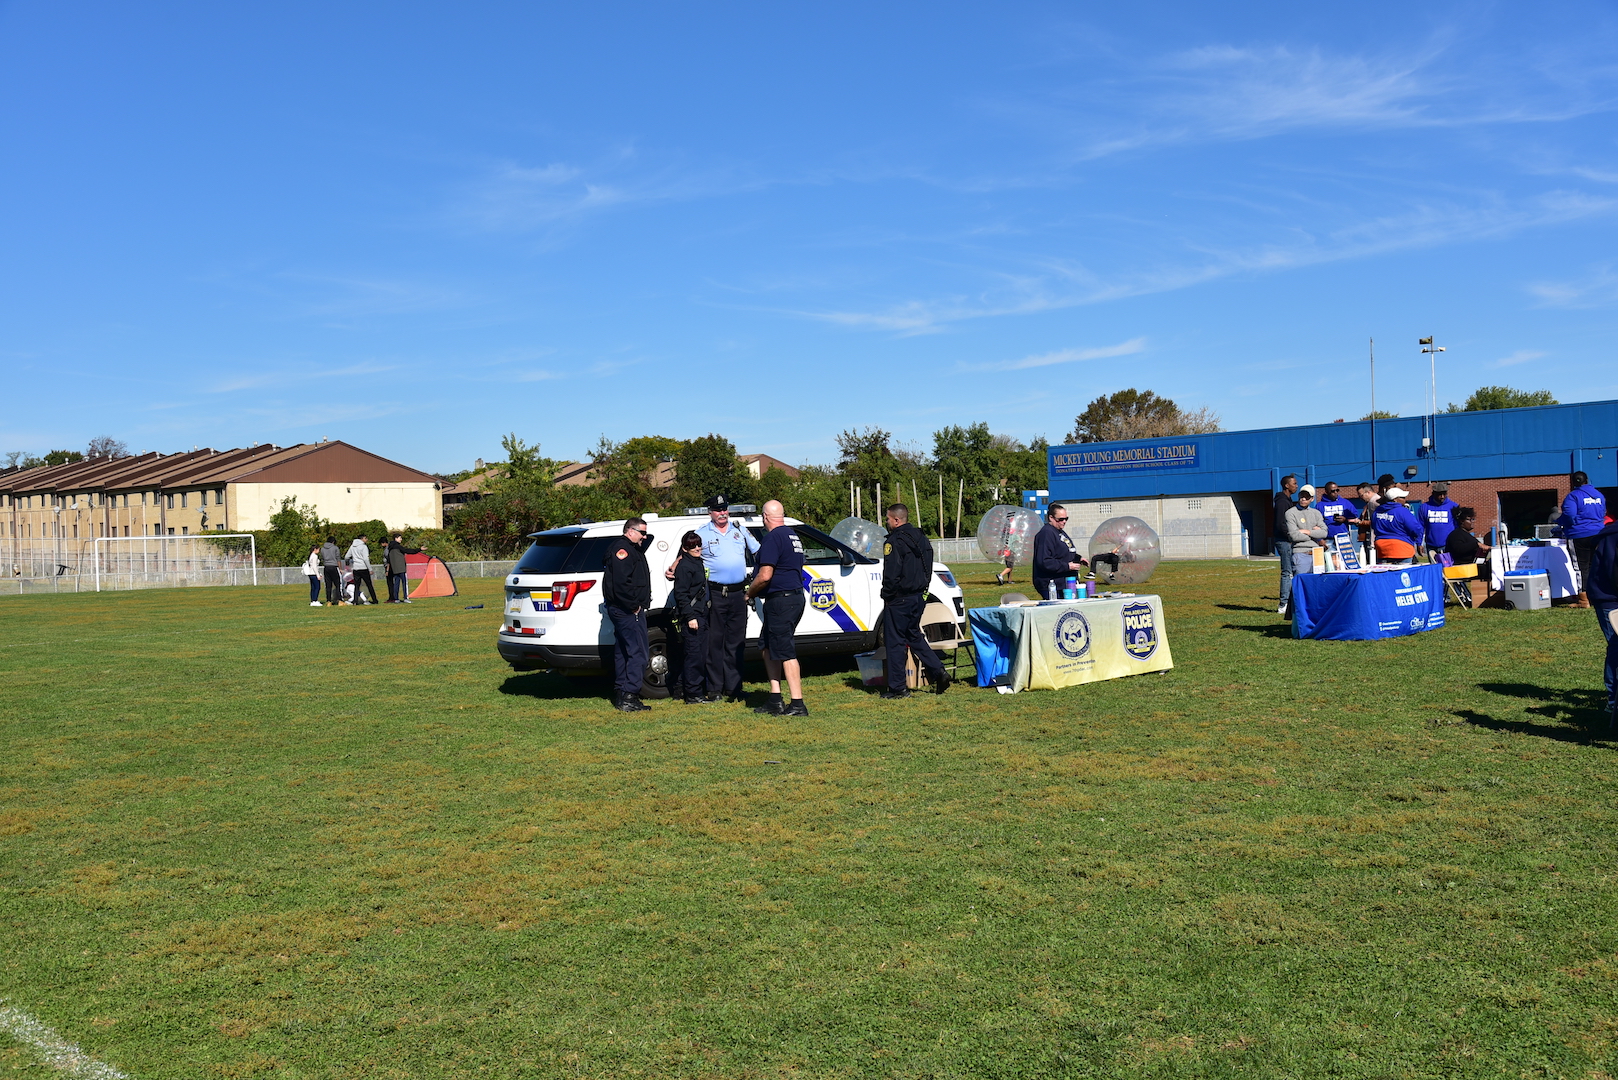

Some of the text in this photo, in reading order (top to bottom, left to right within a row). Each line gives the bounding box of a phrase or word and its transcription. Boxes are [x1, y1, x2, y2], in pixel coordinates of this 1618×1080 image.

[1053, 445, 1196, 466] MICKEY YOUNG MEMORIAL STADIUM
[813, 586, 833, 594] POLICE
[1414, 592, 1429, 603] GYM
[1126, 614, 1152, 630] POLICE
